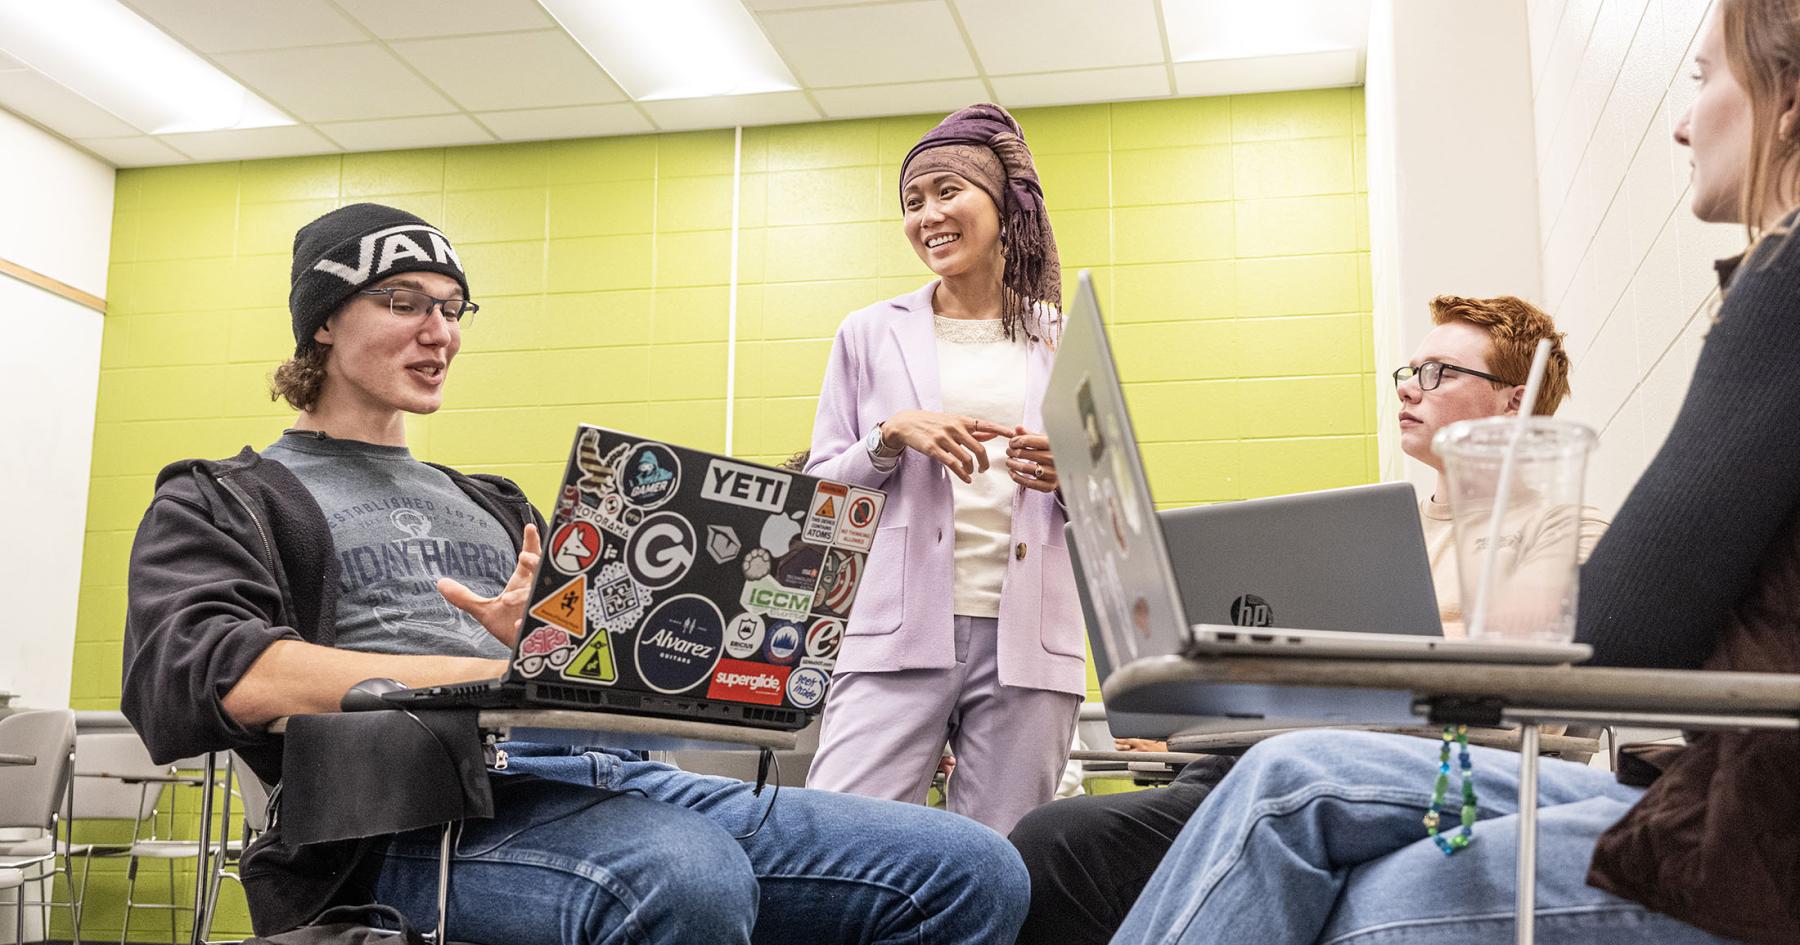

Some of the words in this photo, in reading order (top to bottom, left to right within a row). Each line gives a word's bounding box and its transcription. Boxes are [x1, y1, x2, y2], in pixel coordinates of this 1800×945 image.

[631, 481, 668, 497] GAMER
[713, 467, 784, 505] YETI
[807, 529, 832, 540] ATOMS
[750, 588, 811, 611] ICCM
[1237, 592, 1269, 627] hp
[641, 628, 713, 658] Alvarez
[659, 652, 691, 664] GUITARS
